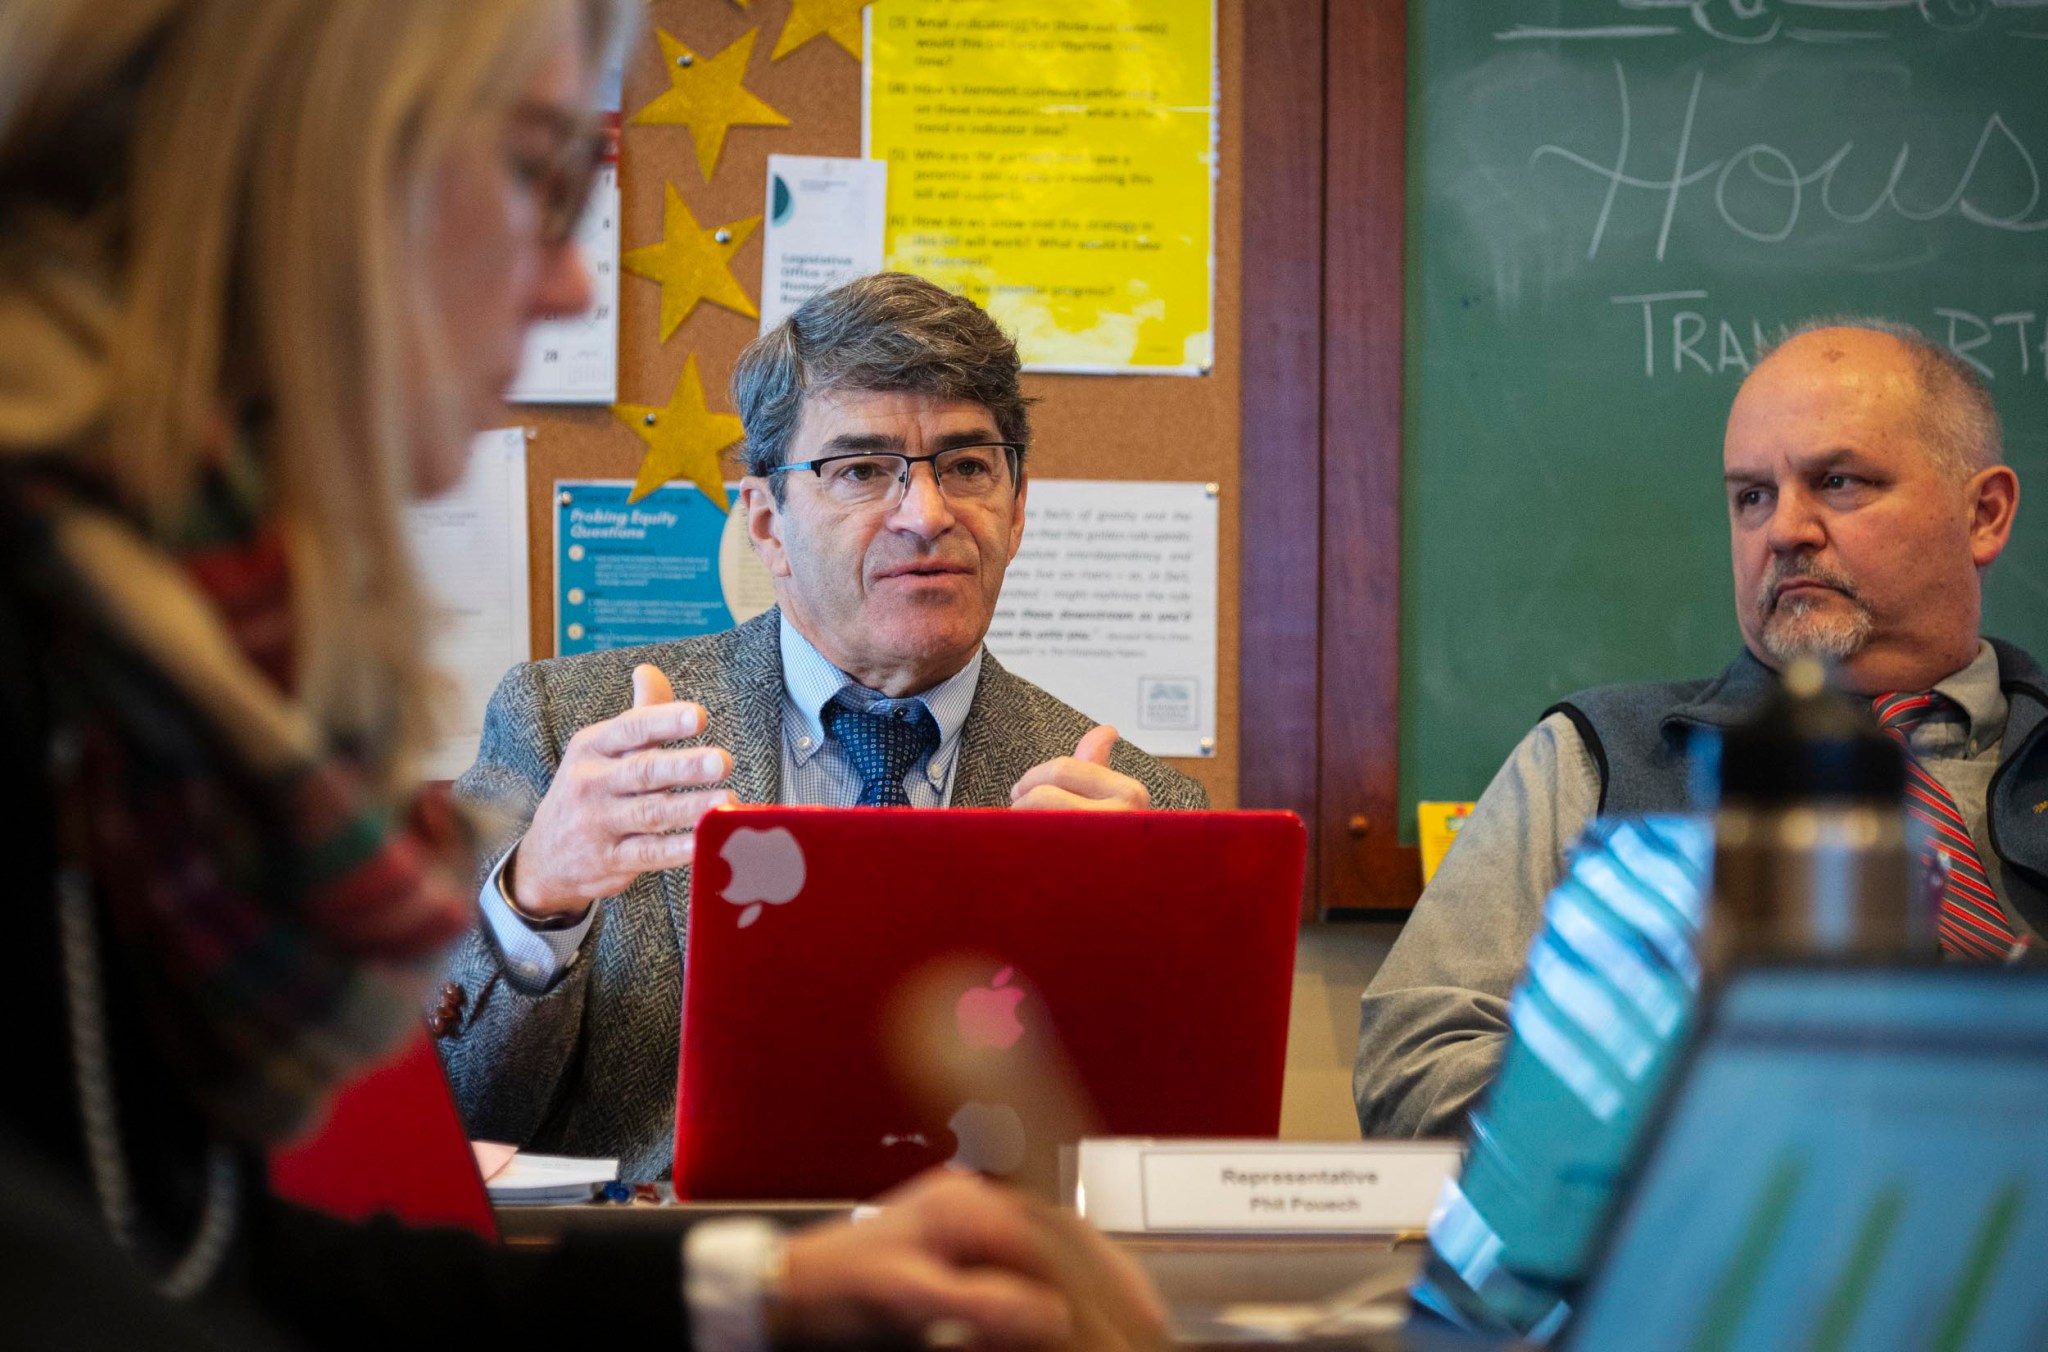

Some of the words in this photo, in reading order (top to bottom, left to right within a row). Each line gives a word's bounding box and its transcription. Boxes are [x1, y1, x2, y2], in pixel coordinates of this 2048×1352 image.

[570, 509, 628, 527] Probing
[630, 510, 678, 528] Equity
[570, 525, 646, 539] Questions
[1221, 1168, 1379, 1188] Representative
[1249, 1197, 1288, 1213] Phil
